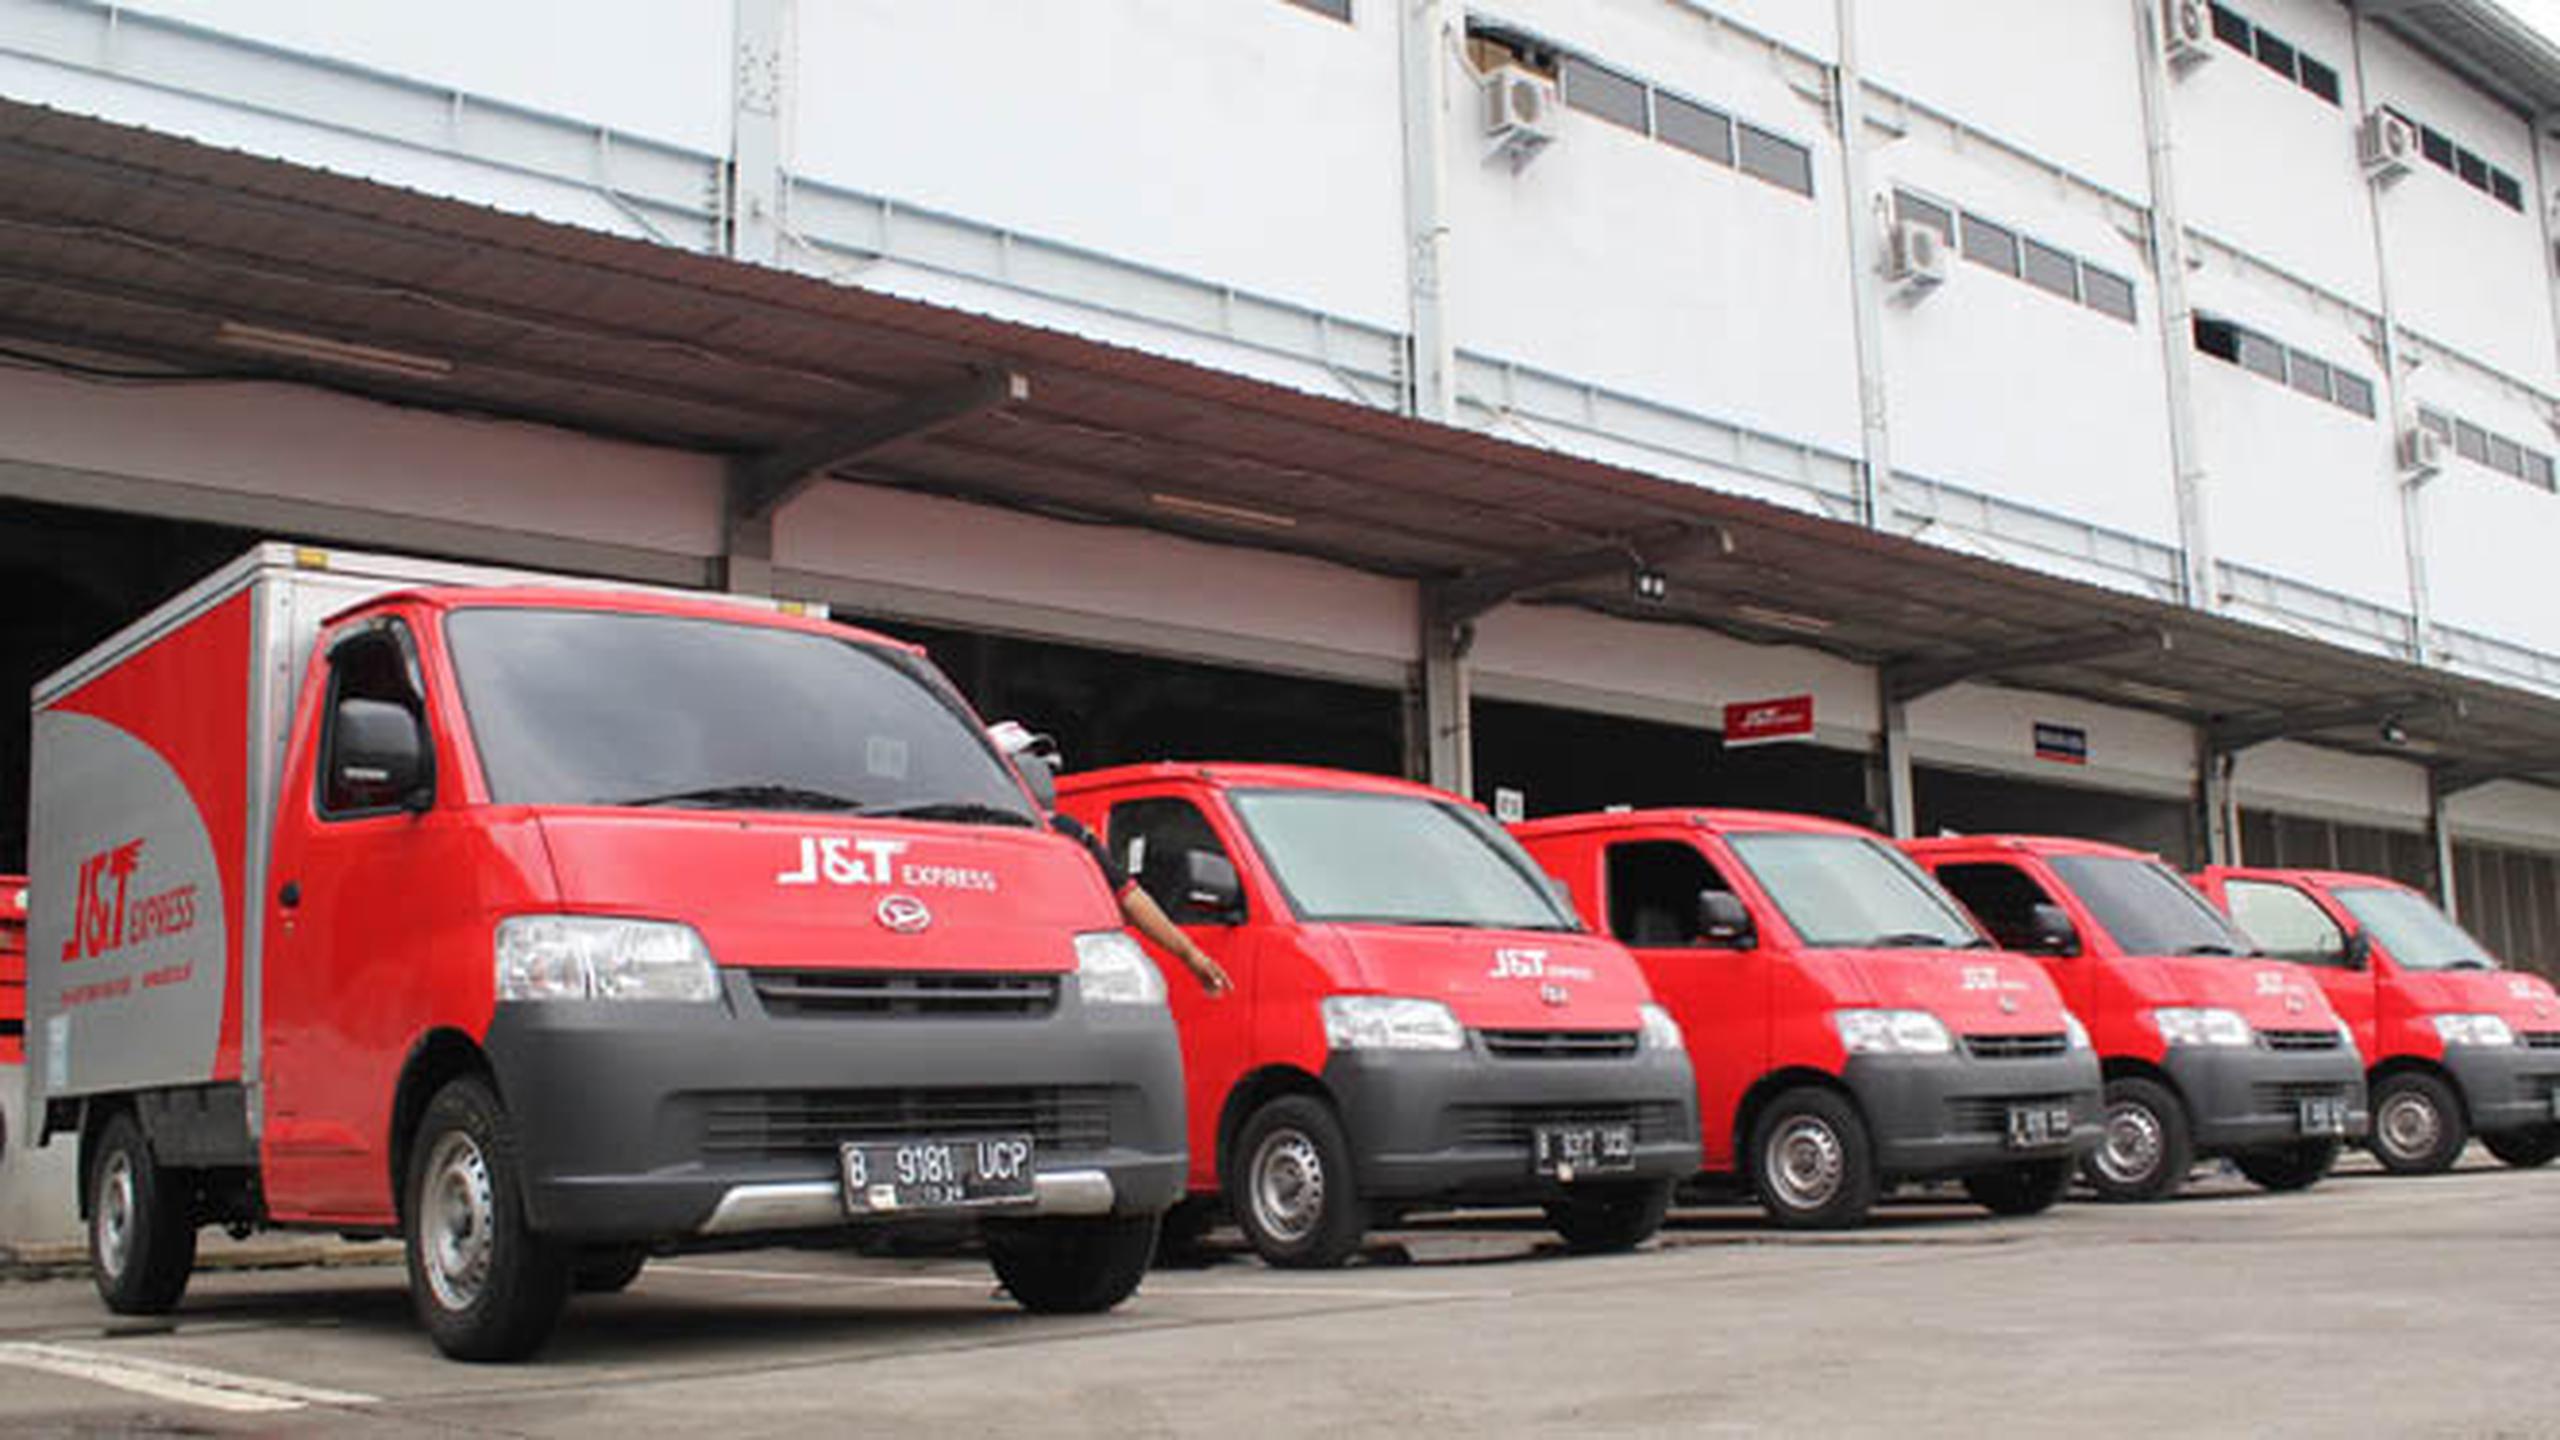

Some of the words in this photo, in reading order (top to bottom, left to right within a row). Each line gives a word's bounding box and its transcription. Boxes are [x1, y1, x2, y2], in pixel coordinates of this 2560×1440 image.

[777, 837, 908, 884] J&T
[902, 864, 998, 893] EXPRESS
[62, 838, 145, 962] J&T
[1489, 948, 1548, 978] J&T
[849, 1149, 867, 1188] B
[897, 1145, 954, 1184] 9181
[978, 1141, 1028, 1179] UCP
